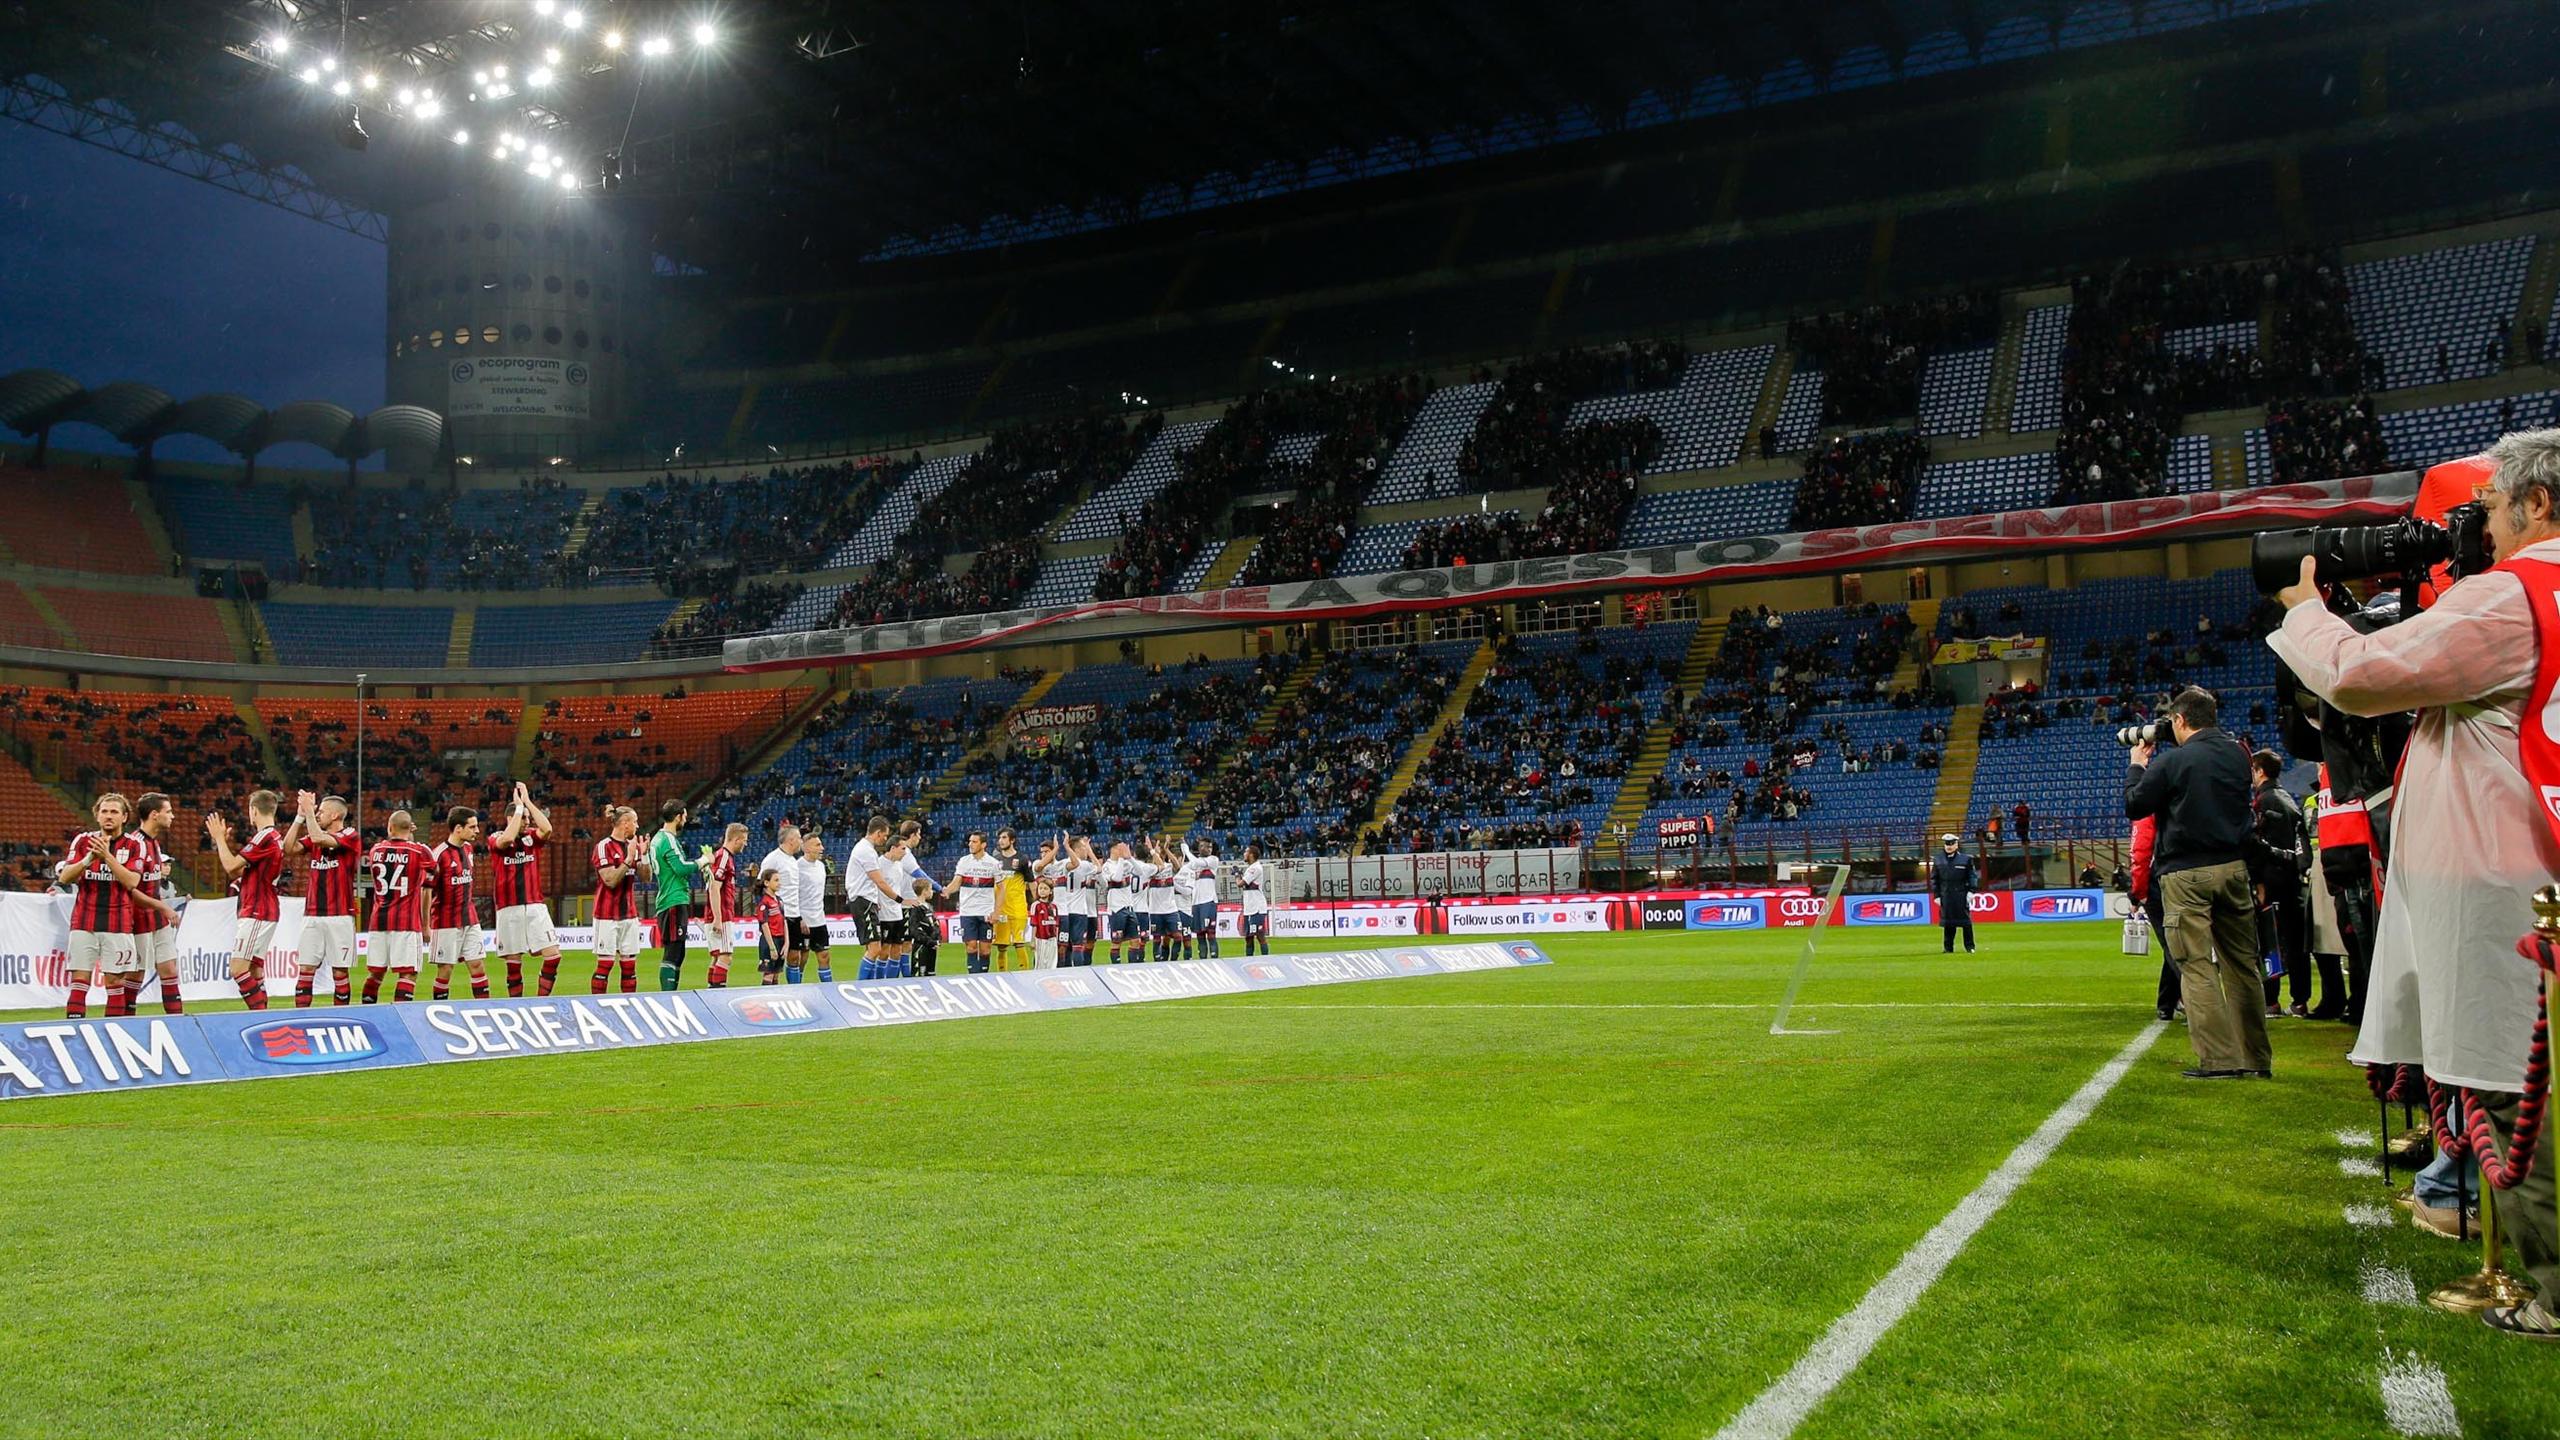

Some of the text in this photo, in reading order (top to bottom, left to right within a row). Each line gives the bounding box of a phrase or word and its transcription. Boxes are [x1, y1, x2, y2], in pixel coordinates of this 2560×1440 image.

[478, 358, 560, 370] ecoprogram
[1286, 578, 1356, 606] A
[1376, 536, 1782, 601] QUESTO
[1660, 820, 1697, 834] SUPER
[1660, 833, 1698, 848] PIPPO
[373, 851, 384, 862] DE
[385, 852, 409, 864] JONG
[1403, 856, 1445, 872] TGRE
[372, 863, 409, 898] 34
[1322, 879, 1350, 893] CHE
[1360, 877, 1401, 893] GIOCO
[1882, 902, 1916, 918] TIM
[2054, 897, 2090, 914] TIM
[1453, 913, 1520, 926] Follow us on
[1645, 909, 1683, 922] 00:00
[1721, 907, 1752, 922] TIM
[1307, 919, 1320, 929] us
[1783, 919, 1804, 927] Audi
[115, 949, 132, 967] 22
[342, 947, 350, 962] 7
[0, 953, 31, 985] ne
[264, 945, 300, 979] nlus
[1262, 964, 1287, 980] TIM
[1290, 955, 1352, 983] SERIE
[1353, 950, 1393, 977] TIM
[1106, 960, 1240, 1000] SERIE A TIM
[1060, 979, 1094, 998] TIM
[837, 974, 1028, 1022] SERIE A TIM
[766, 999, 812, 1020] TIM
[425, 994, 708, 1056] SERIE A TIM
[305, 1024, 374, 1055] TIM
[24, 1019, 192, 1085] TIM
